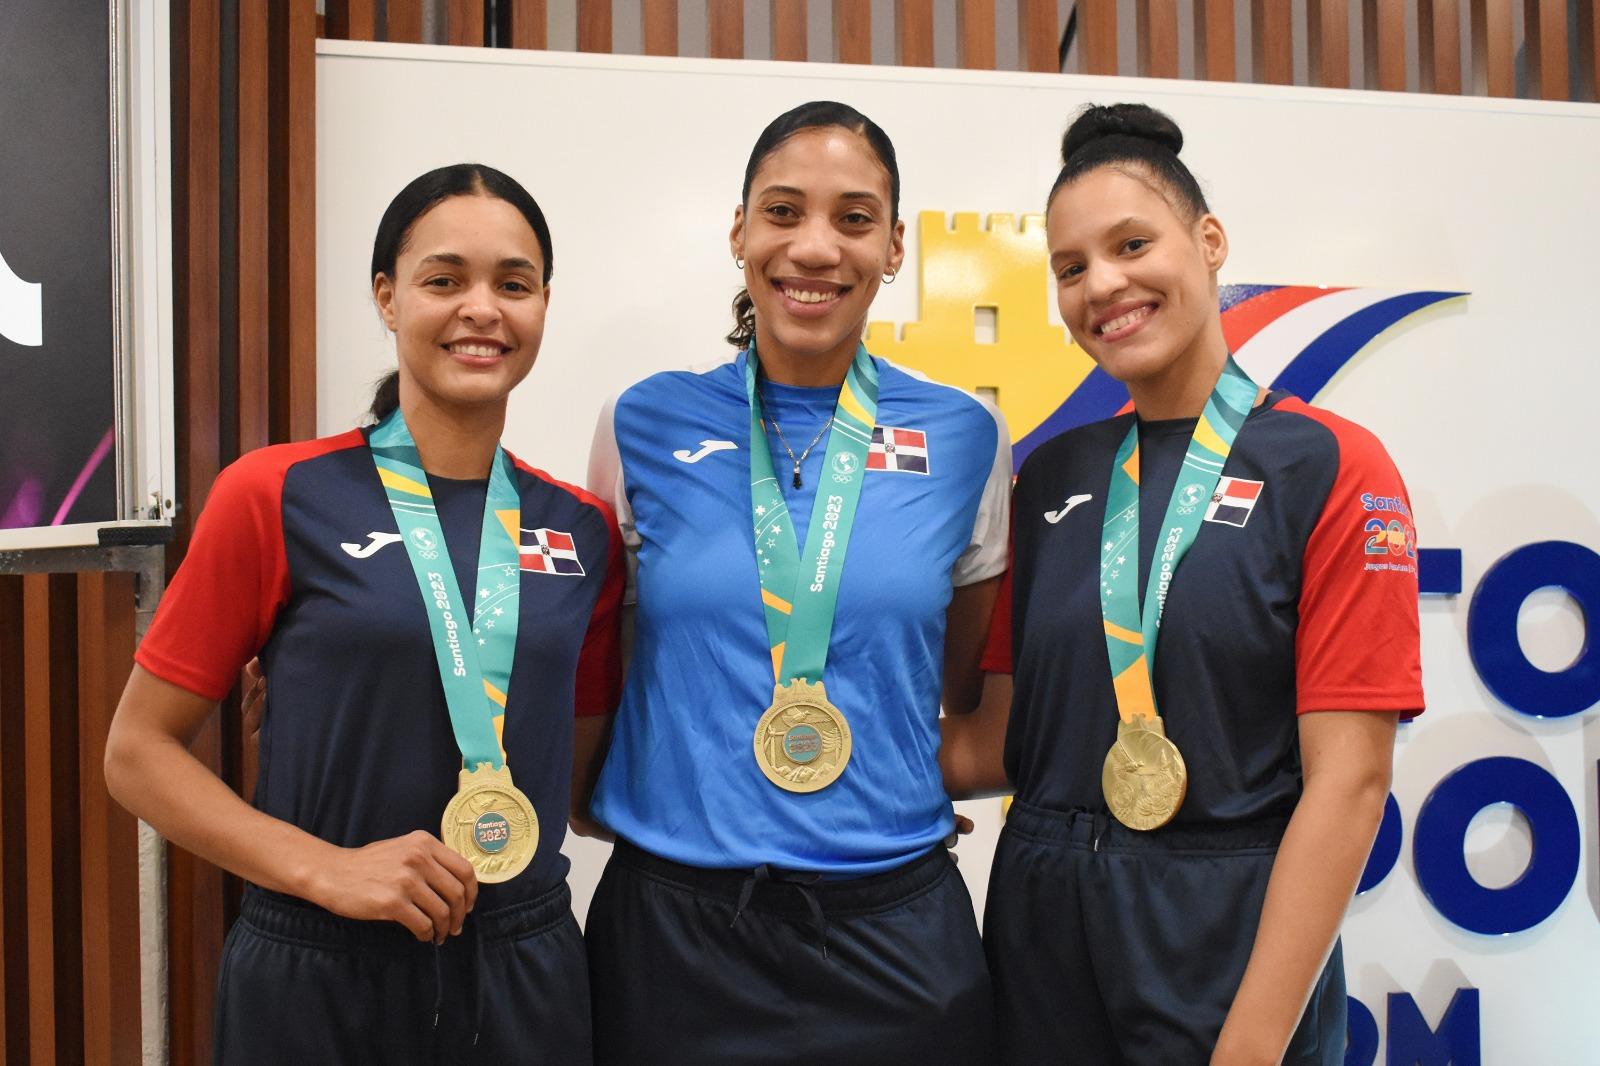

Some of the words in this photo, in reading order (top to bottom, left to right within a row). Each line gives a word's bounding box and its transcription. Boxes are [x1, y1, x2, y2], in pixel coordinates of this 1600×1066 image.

[822, 495, 843, 530] 2023
[810, 531, 835, 593] Santiago
[1162, 527, 1183, 562] 2023
[427, 571, 450, 609] 2023
[443, 612, 466, 677] Santiago
[478, 820, 507, 830] Santiago
[479, 828, 508, 842] 2023
